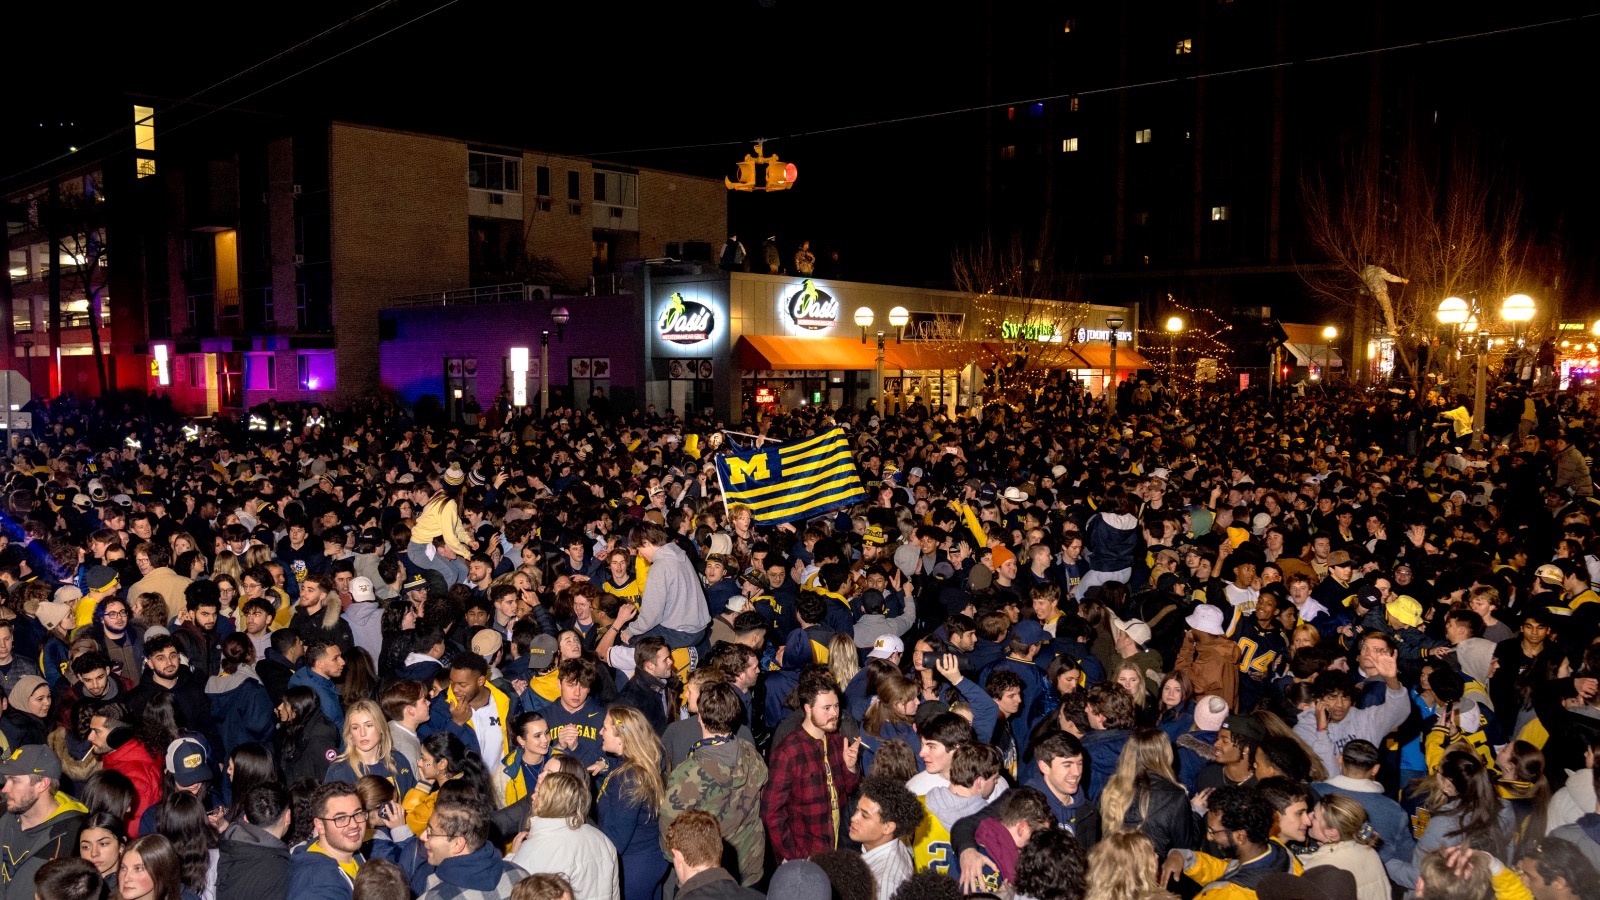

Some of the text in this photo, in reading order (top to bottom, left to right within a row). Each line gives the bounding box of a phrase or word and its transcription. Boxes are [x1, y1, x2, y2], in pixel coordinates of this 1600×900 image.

[794, 289, 839, 319] Oasis
[658, 303, 710, 333] Oasis
[1086, 329, 1110, 342] JIMMY
[724, 452, 771, 485] M
[875, 639, 885, 648] M
[489, 716, 502, 727] M
